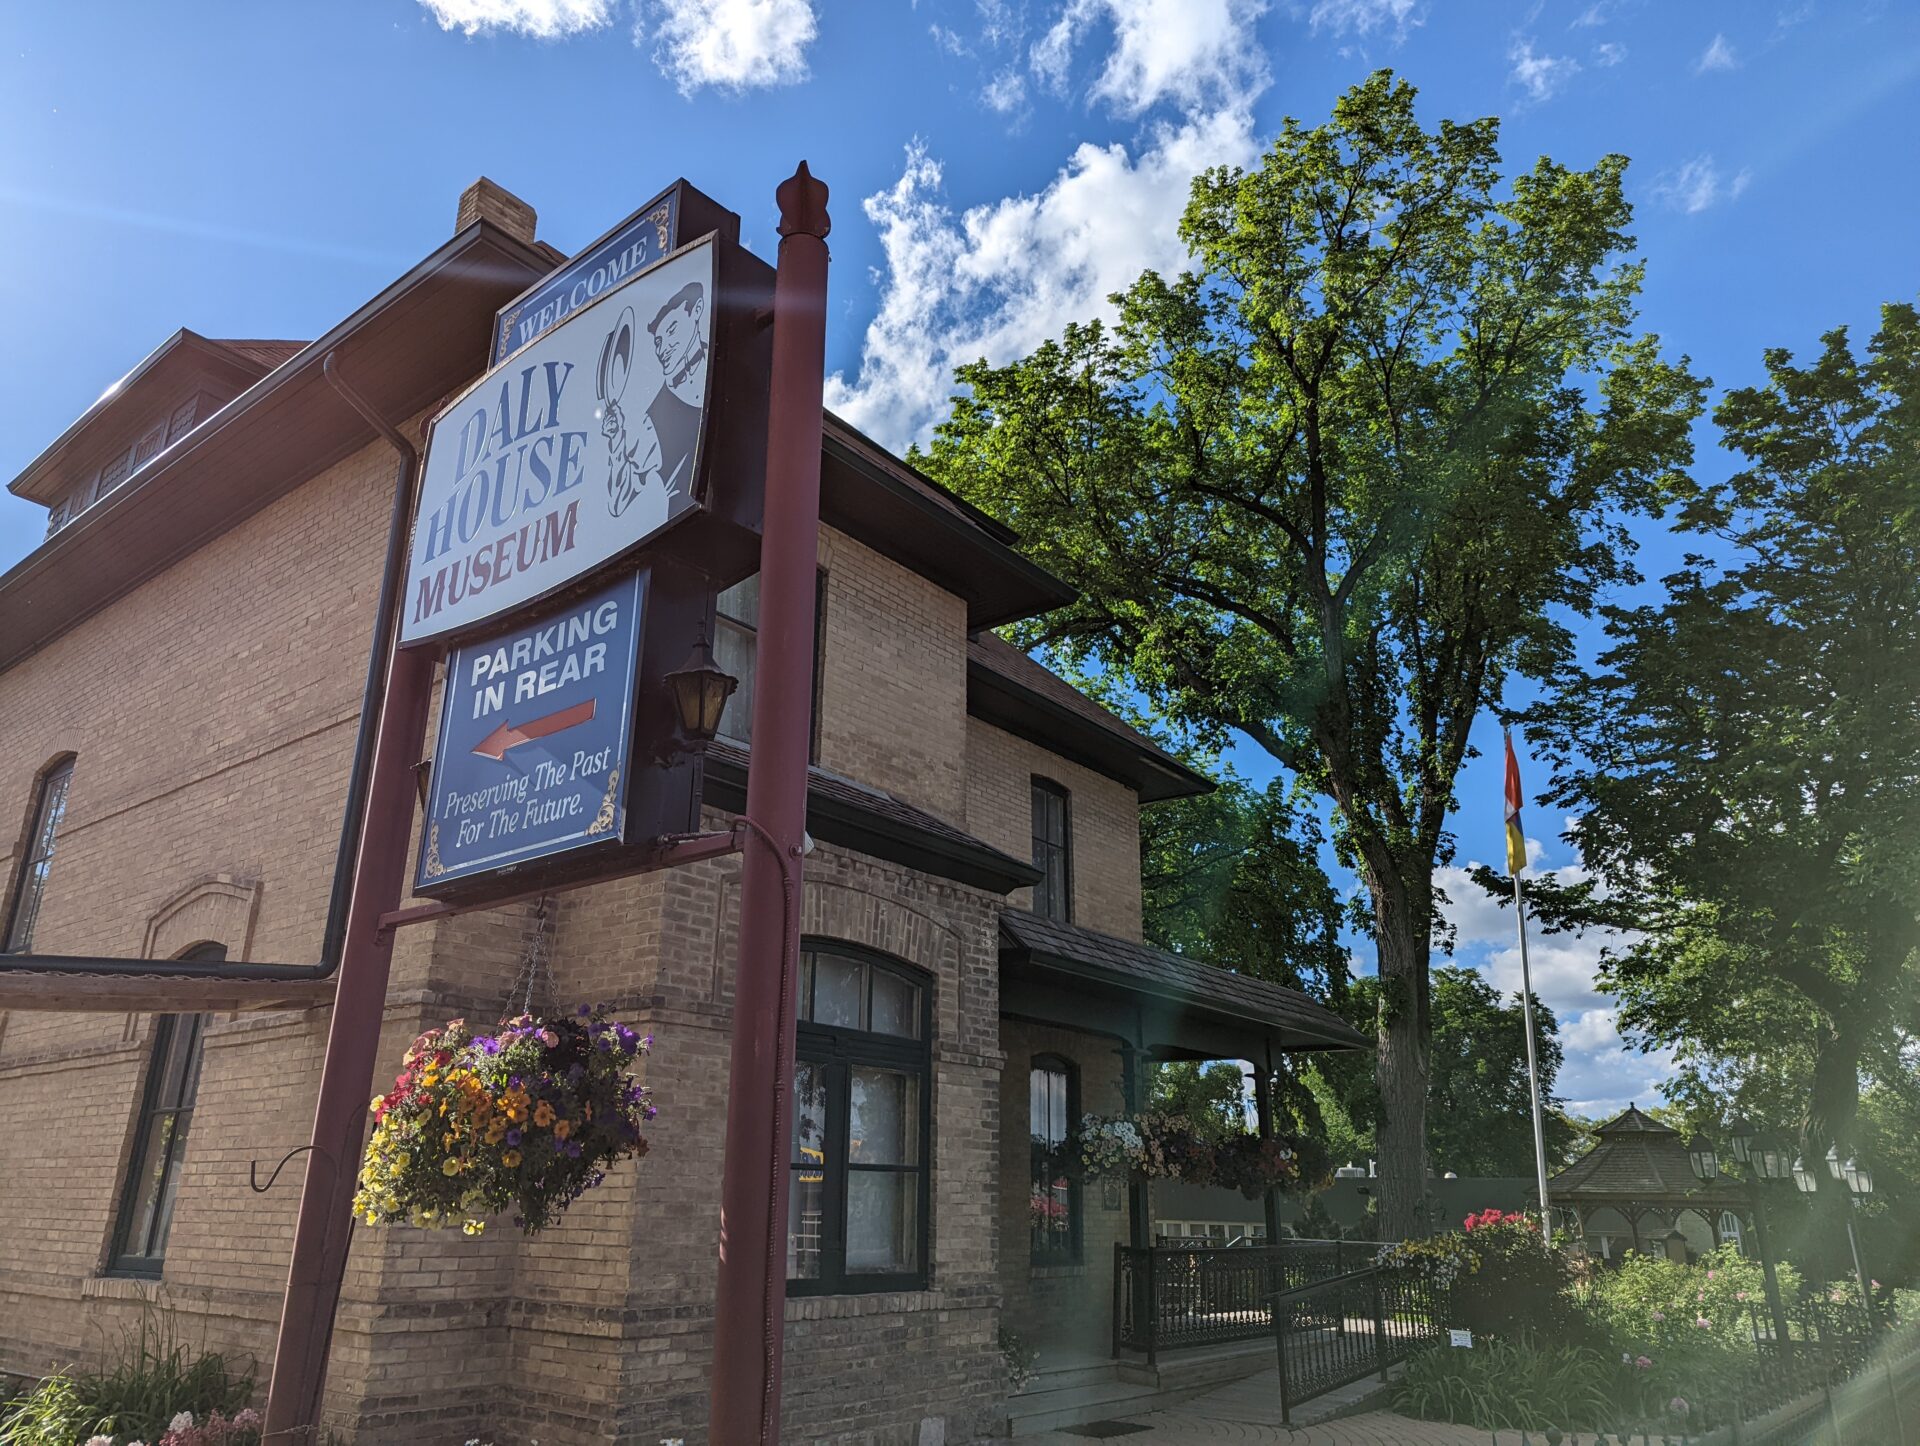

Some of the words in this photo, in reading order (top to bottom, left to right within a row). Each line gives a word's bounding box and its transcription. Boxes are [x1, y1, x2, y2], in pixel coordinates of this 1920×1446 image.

[519, 236, 647, 344] WELCOME
[454, 361, 574, 485] DALY
[423, 431, 588, 565] HOUSE
[413, 499, 582, 625] MUSEUM
[471, 600, 618, 686] PARKING
[472, 681, 505, 719] IN
[514, 643, 607, 704] REAR
[444, 774, 529, 819] Preserving
[534, 760, 566, 792] The
[569, 746, 612, 781] Past
[456, 817, 484, 847] For
[490, 808, 518, 840] The
[522, 792, 583, 829] Future.
